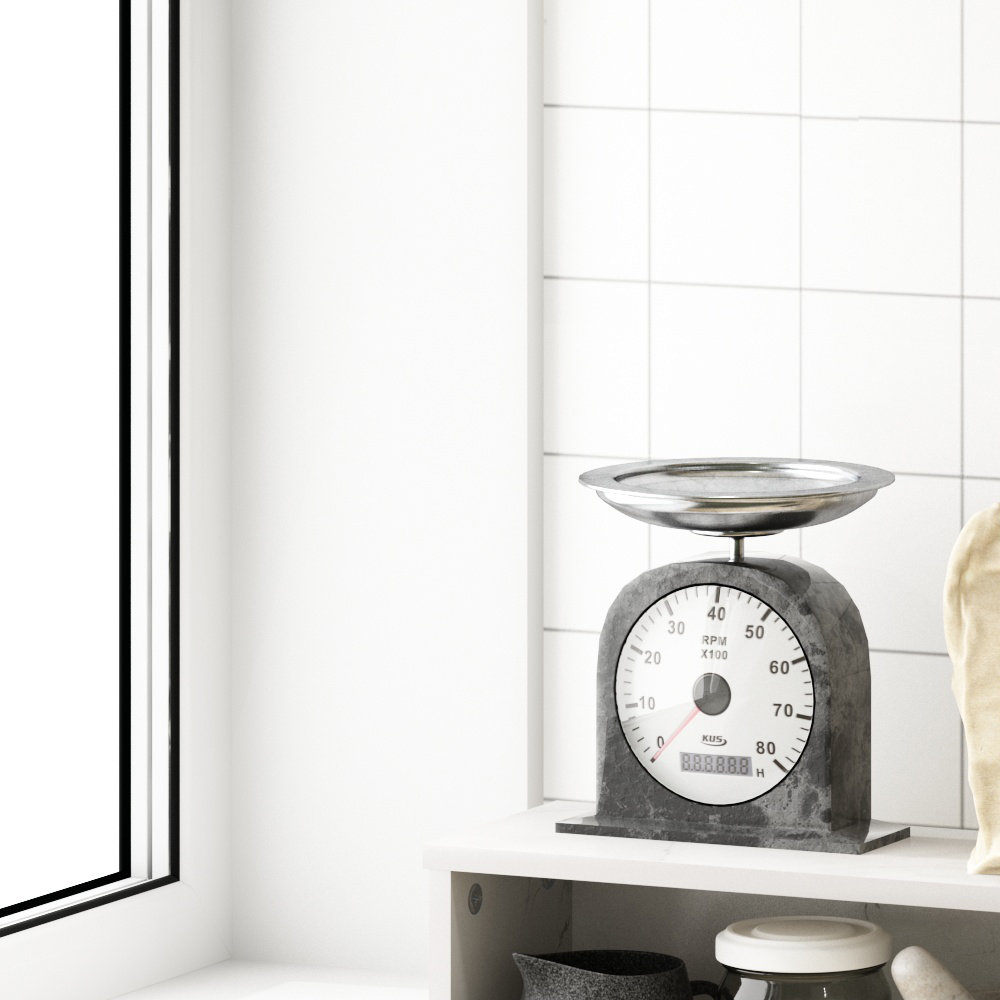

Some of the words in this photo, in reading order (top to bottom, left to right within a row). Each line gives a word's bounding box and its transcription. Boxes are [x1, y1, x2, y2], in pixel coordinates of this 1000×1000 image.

[707, 606, 726, 621] 40
[667, 620, 685, 635] 30
[745, 624, 765, 639] 50
[702, 635, 727, 646] RPM
[644, 650, 661, 665] 20
[701, 649, 728, 660] X100
[769, 660, 790, 675] 60
[639, 695, 655, 711] 10
[773, 703, 793, 718] 70
[656, 736, 665, 749] 0
[702, 734, 723, 743] KUS
[756, 741, 776, 755] 80
[756, 768, 765, 778] H
